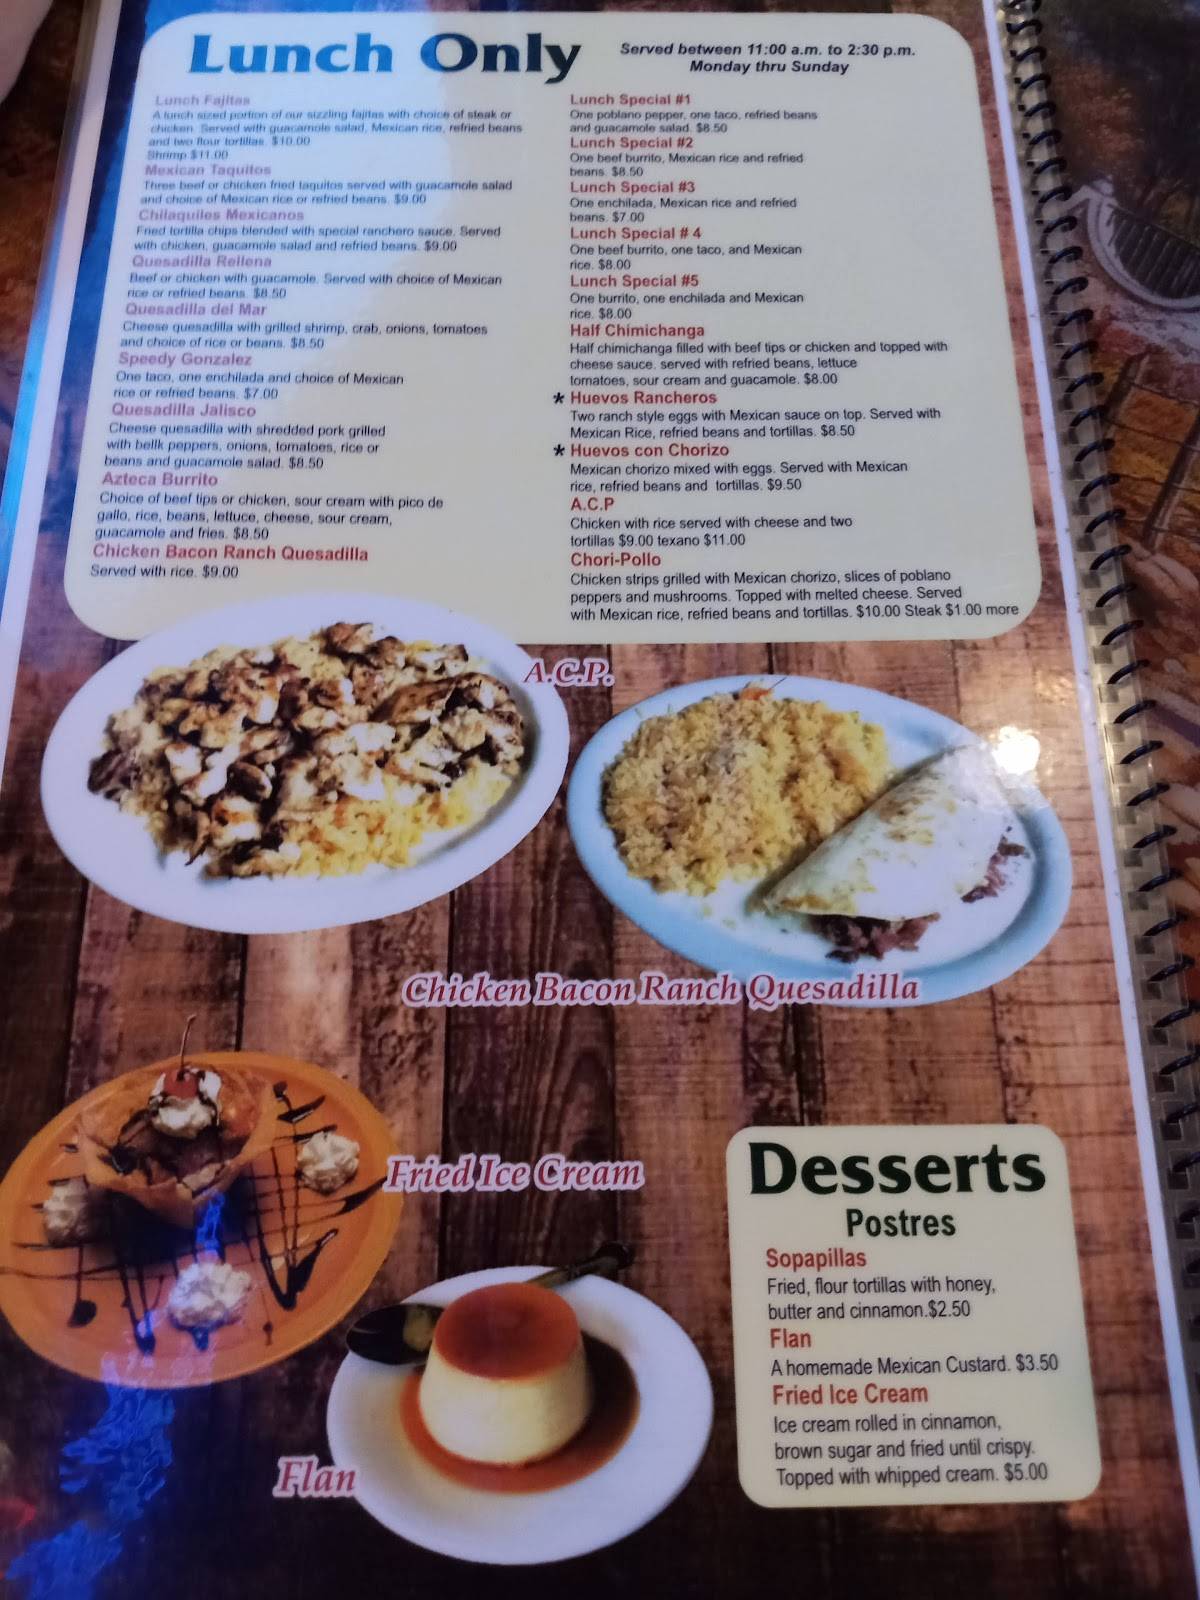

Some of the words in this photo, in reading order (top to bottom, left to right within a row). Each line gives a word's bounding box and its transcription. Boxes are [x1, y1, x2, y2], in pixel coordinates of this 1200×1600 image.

[188, 32, 394, 74] Lunch
[420, 31, 582, 84] Only
[619, 42, 674, 55] Served
[676, 43, 742, 55] between
[746, 43, 787, 55] 11:00
[790, 46, 822, 55] a.m.
[826, 44, 843, 56] to
[846, 43, 879, 56] 2:30
[882, 46, 915, 58] p.m.
[689, 60, 751, 75] Monday
[755, 60, 787, 72] thru
[790, 60, 850, 75] Sunday
[154, 94, 200, 106] Lunch
[203, 94, 251, 107] Fajitas
[569, 93, 615, 105] Lunch
[618, 93, 671, 107] Special
[674, 93, 691, 105] #1
[569, 136, 616, 149] Lunch
[618, 136, 673, 151] Special
[675, 136, 694, 149] #2
[146, 149, 189, 161] Shrimp
[189, 148, 229, 160] $11.00
[144, 163, 205, 176] Mexican
[209, 163, 272, 178] Taquitos
[569, 181, 616, 193] Lunch
[619, 180, 674, 195] Special
[677, 180, 696, 193] #3
[137, 208, 221, 222] Chilaquiles
[224, 208, 305, 221] Mexicanos
[569, 226, 617, 239] Lunch
[620, 226, 676, 242] Special
[131, 254, 211, 268] Quesadilla
[215, 254, 272, 267] Rellena
[569, 259, 594, 270] rice.
[597, 258, 632, 271] $8.00
[569, 274, 617, 287] Lunch
[621, 273, 677, 290] Special
[680, 274, 699, 287] #5
[124, 302, 206, 316] Quesadilla
[210, 302, 234, 316] del
[237, 302, 268, 316] Mar
[569, 323, 601, 337] Half
[604, 323, 705, 340] Chimichanga
[117, 351, 177, 368] Speedy
[179, 352, 252, 366] Gonzalez
[569, 391, 629, 405] Huevos
[632, 390, 718, 404] Rancheros
[110, 402, 195, 416] Quesadilla
[199, 403, 257, 417] Jalisco
[569, 409, 596, 422] Two
[597, 410, 633, 422] ranch
[635, 410, 665, 424] style
[667, 412, 699, 425] eggs
[700, 409, 726, 421] with
[728, 409, 781, 421] Mexican
[783, 411, 821, 421] sauce
[823, 410, 840, 420] on
[842, 408, 866, 422] top.
[868, 407, 914, 420] Served
[915, 407, 941, 419] with
[569, 443, 630, 457] Huevos
[633, 446, 663, 457] con
[667, 442, 730, 457] Chorizo
[101, 471, 157, 486] Azteca
[160, 471, 218, 487] Burrito
[569, 496, 615, 511] A.C.P
[317, 514, 346, 524] sour
[569, 516, 621, 530] Chicken
[623, 517, 650, 529] with
[652, 517, 676, 529] rice
[678, 516, 722, 529] served
[724, 516, 750, 528] with
[753, 516, 800, 528] cheese
[802, 515, 827, 528] and
[829, 515, 853, 527] two
[94, 526, 166, 540] guacamole
[168, 526, 194, 539] and
[232, 526, 269, 540] $8.50
[92, 543, 160, 558] Chicken
[164, 544, 218, 559] Bacon
[222, 544, 276, 560] Ranch
[280, 545, 368, 561] Quesadilla
[570, 551, 661, 567] Chori-Pollo
[89, 564, 137, 577] Served
[139, 564, 166, 577] with
[201, 564, 239, 578] $9.00
[569, 608, 596, 621] with
[599, 607, 653, 621] Mexican
[655, 607, 684, 621] rice,
[686, 607, 728, 620] refried
[731, 607, 772, 620] beans
[774, 606, 799, 619] and
[801, 605, 852, 618] tortillas.
[855, 604, 901, 618] $10.00
[903, 603, 942, 617] Steak
[944, 602, 982, 617] $1.00
[984, 605, 1019, 615] more
[523, 658, 616, 687] A.C.P.
[404, 974, 531, 1006] Chicken
[534, 975, 635, 1005] Bacon
[638, 974, 744, 1003] Ranch
[747, 972, 920, 1009] Quesadilla
[386, 1155, 471, 1191] Fried
[476, 1156, 528, 1190] Ice
[534, 1155, 645, 1191] Cream
[748, 1142, 1046, 1194] Desserts
[845, 1208, 956, 1237] Postres
[765, 1247, 867, 1272] Sopapillas
[766, 1277, 811, 1297] Fried,
[814, 1276, 849, 1294] flour
[851, 1276, 907, 1294] tortillas
[909, 1275, 942, 1293] with
[944, 1275, 996, 1296] honey,
[767, 1303, 813, 1320] butter
[816, 1302, 845, 1320] and
[769, 1327, 812, 1348] Flan
[770, 1359, 783, 1376] A
[785, 1358, 873, 1376] homemade
[876, 1356, 942, 1374] Mexican
[944, 1355, 1011, 1373] Custard.
[1014, 1353, 1059, 1372] $3.50
[772, 1384, 824, 1405] Fried
[828, 1383, 859, 1405] Ice
[863, 1382, 929, 1404] Cream
[773, 1416, 798, 1434] Ice
[801, 1419, 851, 1433] cream
[854, 1413, 898, 1432] rolled
[901, 1413, 917, 1431] in
[920, 1413, 1001, 1430] cinnamon,
[773, 1442, 823, 1460] brown
[826, 1444, 872, 1463] sugar
[875, 1439, 906, 1458] and
[909, 1438, 945, 1457] fried
[948, 1437, 982, 1456] until
[985, 1437, 1035, 1459] crispy.
[275, 1458, 357, 1496] Flan
[775, 1467, 835, 1490] Topped
[837, 1466, 871, 1485] with
[874, 1465, 941, 1488] whipped
[944, 1468, 999, 1483] cream.
[1003, 1461, 1049, 1482] $5.00
